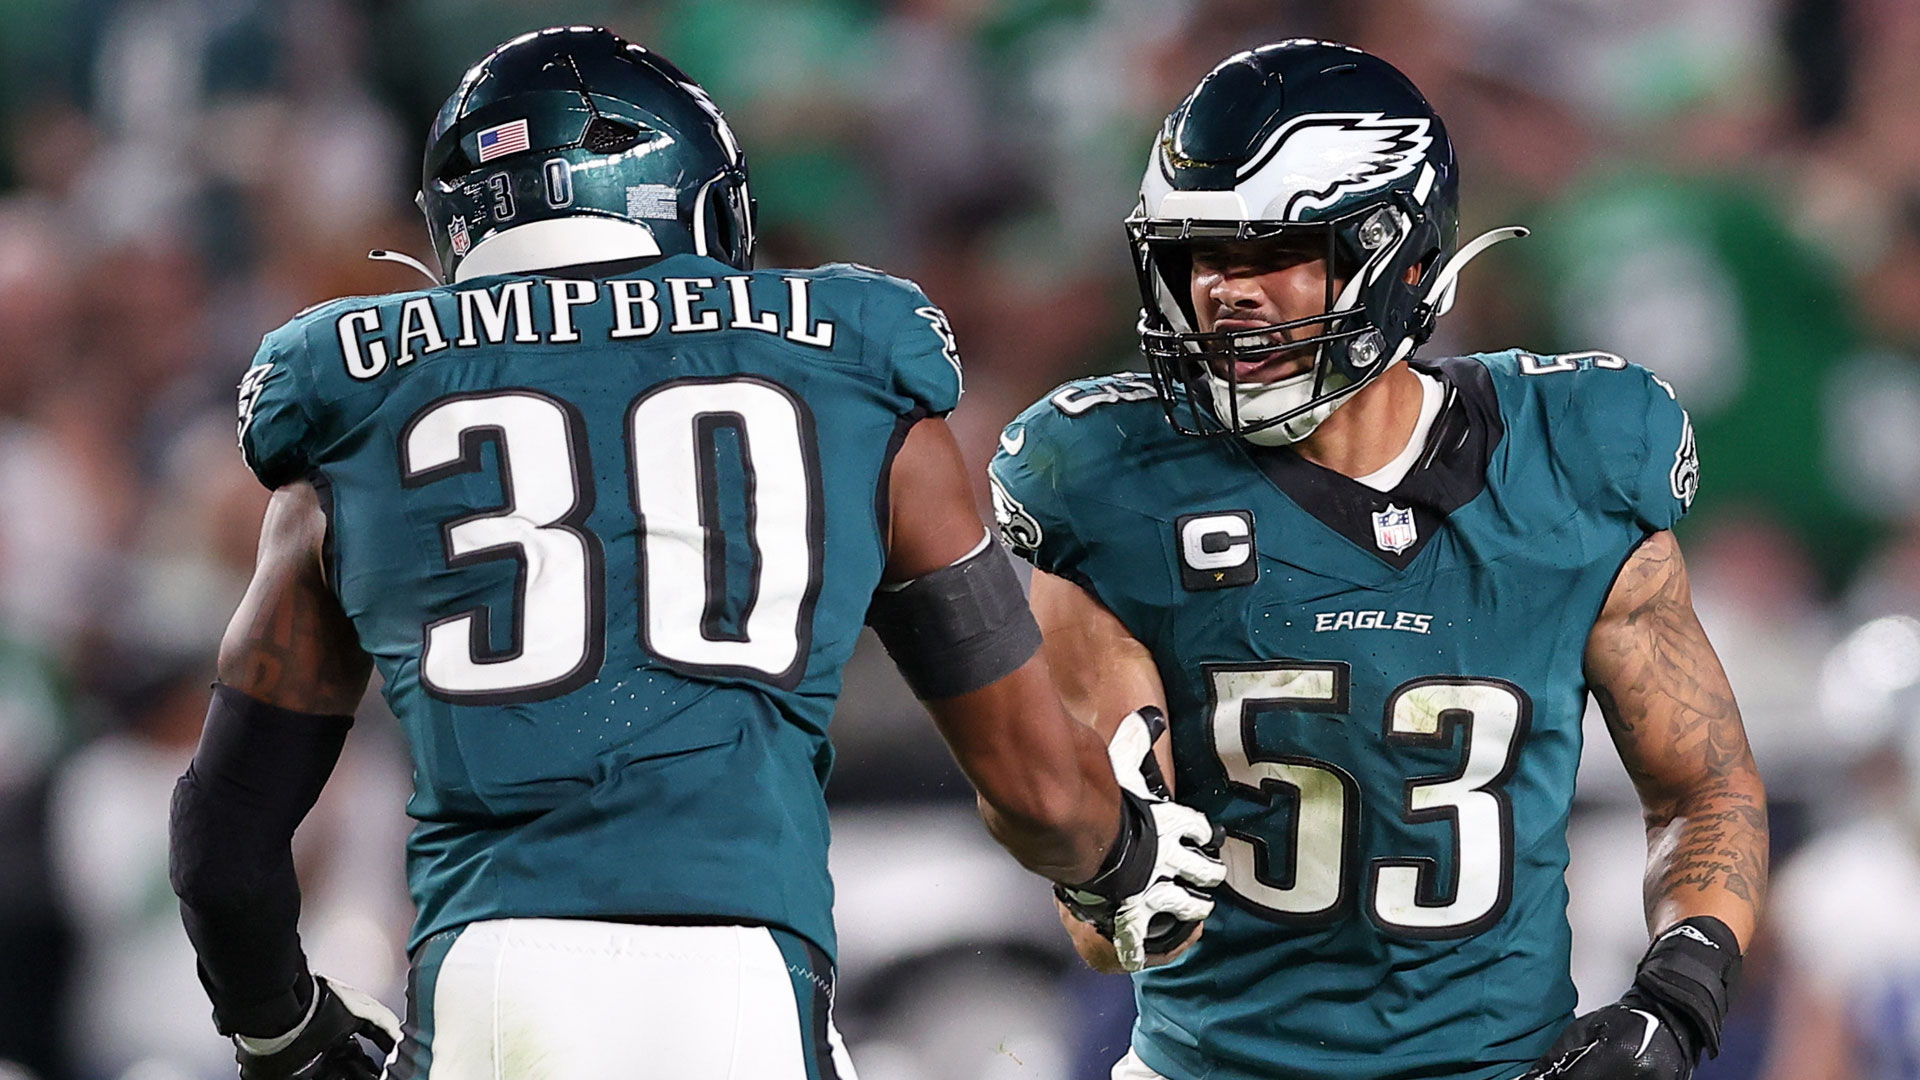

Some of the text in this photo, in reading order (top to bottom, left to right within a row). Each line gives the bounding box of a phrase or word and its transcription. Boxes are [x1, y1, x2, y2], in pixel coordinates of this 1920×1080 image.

[337, 275, 835, 380] CAMPBELL
[402, 373, 825, 706] 30
[1183, 514, 1251, 570] C
[1382, 526, 1410, 545] NFL
[1314, 610, 1434, 634] EAGLES
[1202, 660, 1533, 941] 53
